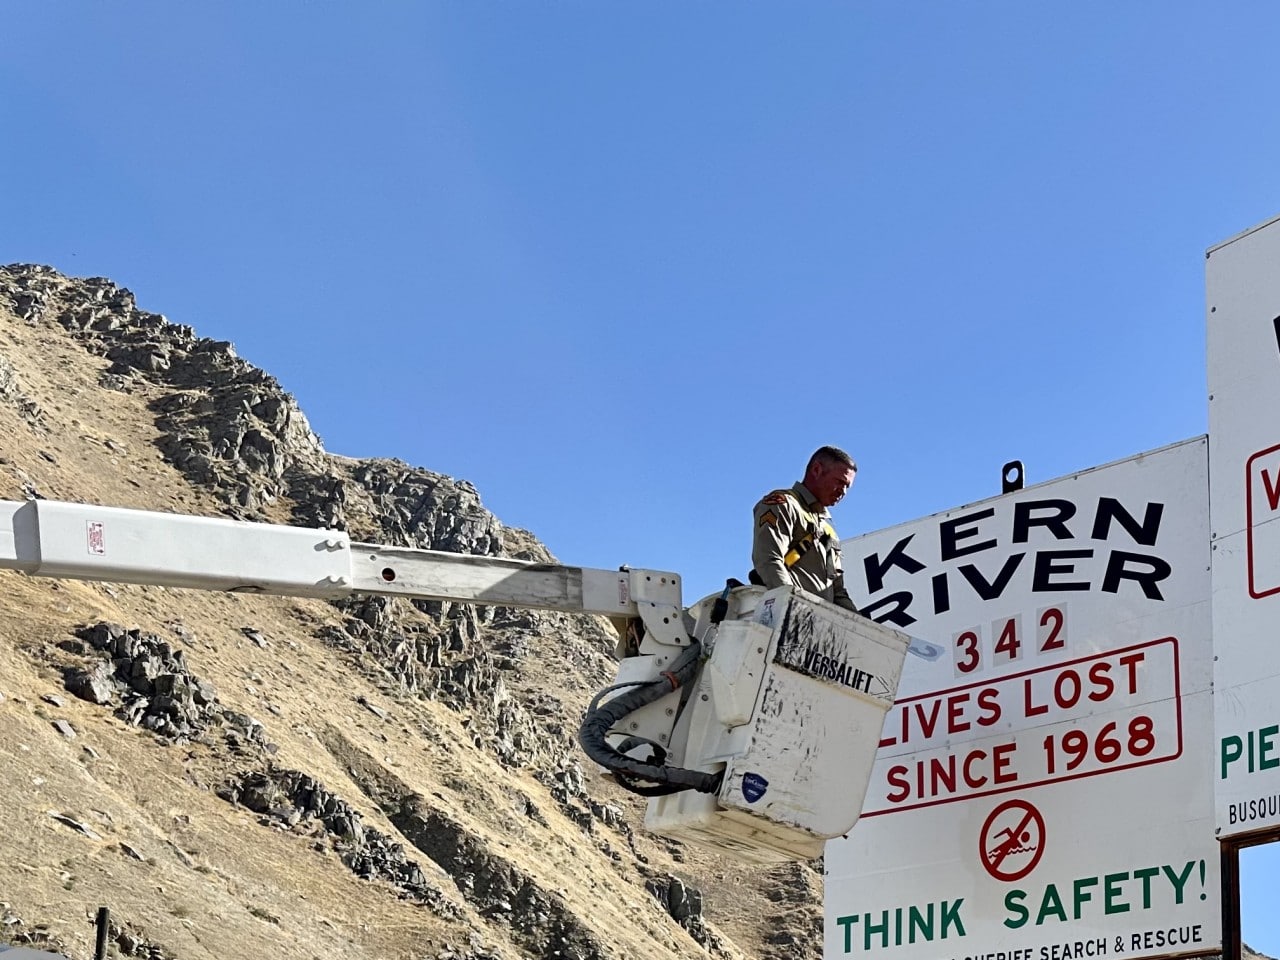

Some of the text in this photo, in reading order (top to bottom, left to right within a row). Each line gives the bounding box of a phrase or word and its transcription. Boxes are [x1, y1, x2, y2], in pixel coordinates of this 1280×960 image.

[863, 496, 1165, 594] KERN
[859, 548, 1173, 628] RIVER
[803, 649, 875, 694] VERSALIFT
[1024, 652, 1146, 717] LOST
[886, 715, 1156, 803] SINCE 1968
[836, 859, 1208, 953] THINK SAFETY!
[1114, 936, 1125, 953] &
[1131, 924, 1203, 950] RESCUE
